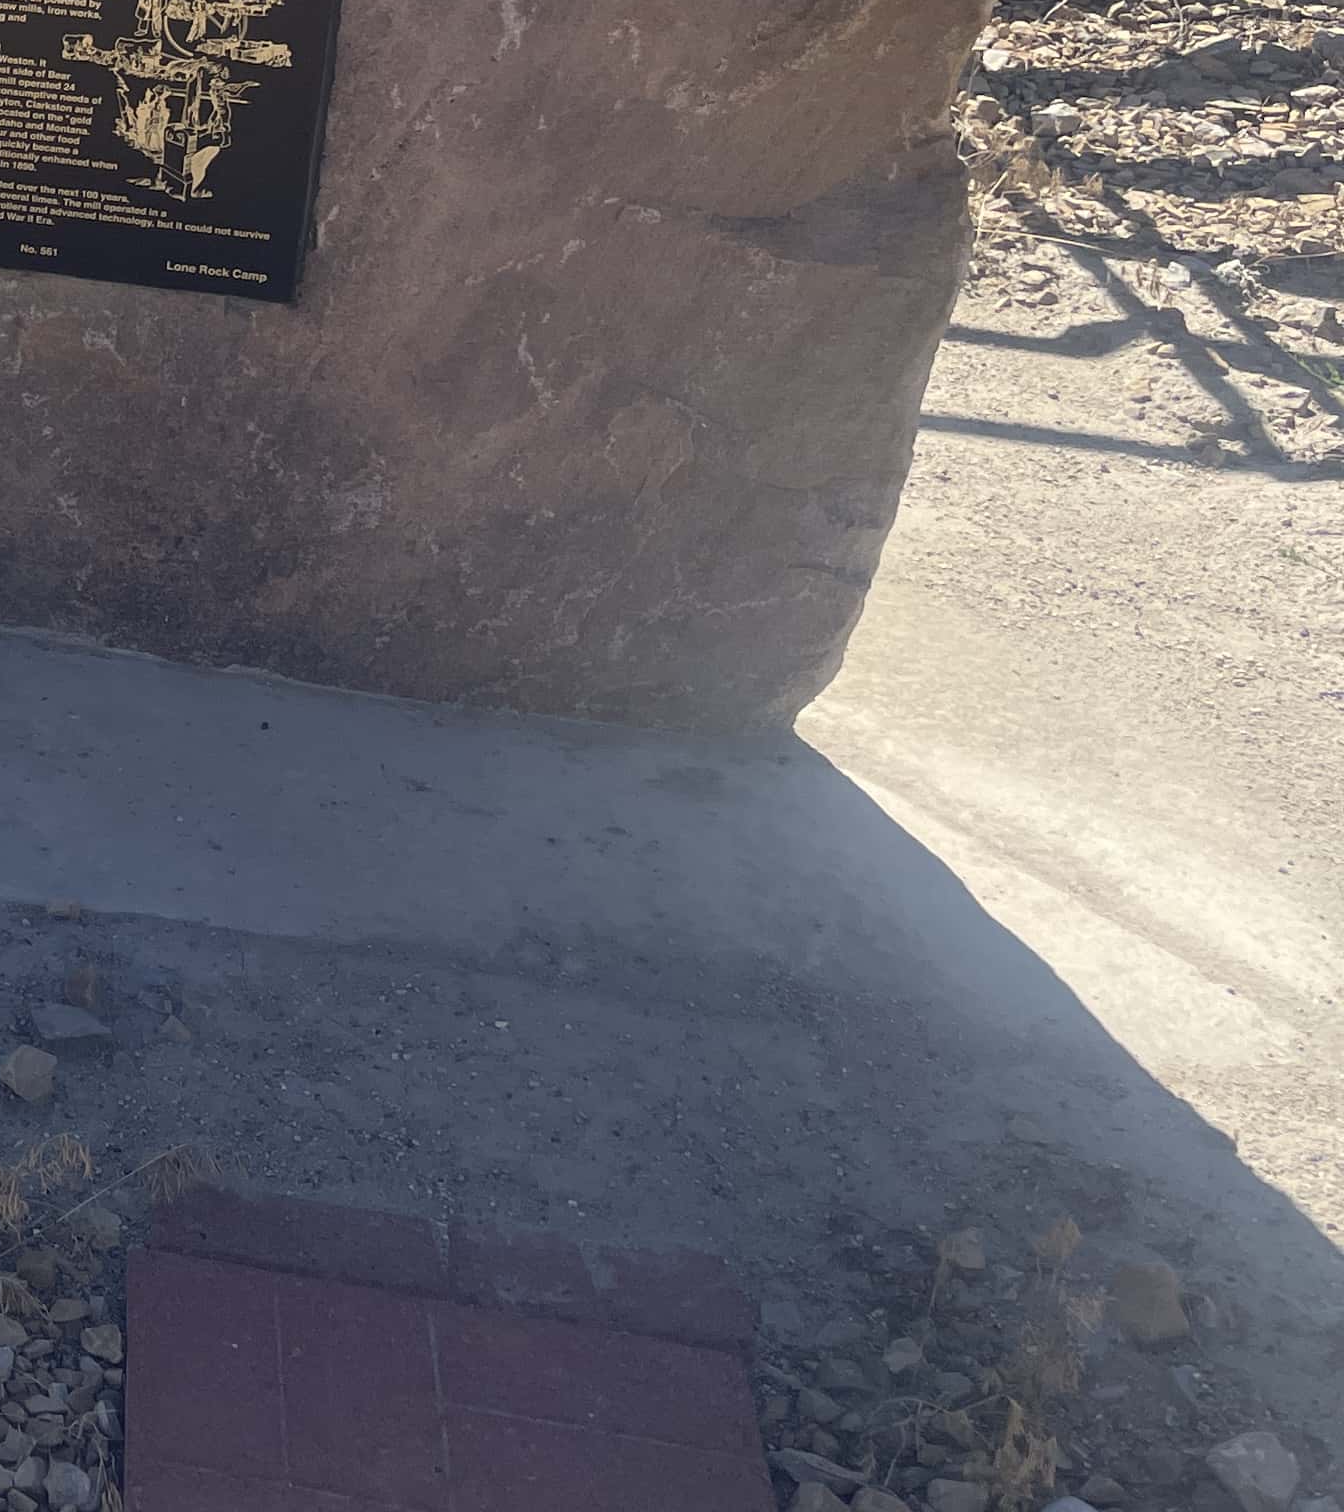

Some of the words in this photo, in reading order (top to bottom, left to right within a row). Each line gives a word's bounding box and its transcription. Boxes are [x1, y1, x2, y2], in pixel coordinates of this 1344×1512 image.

[39, 58, 46, 66] It
[25, 99, 72, 112] Clarkston
[74, 104, 93, 114] and
[9, 129, 28, 138] and
[29, 131, 56, 141] other
[57, 134, 80, 144] food
[20, 243, 37, 254] No.
[166, 260, 197, 273] Lone
[198, 264, 230, 277] Rock
[231, 268, 267, 283] Camp
